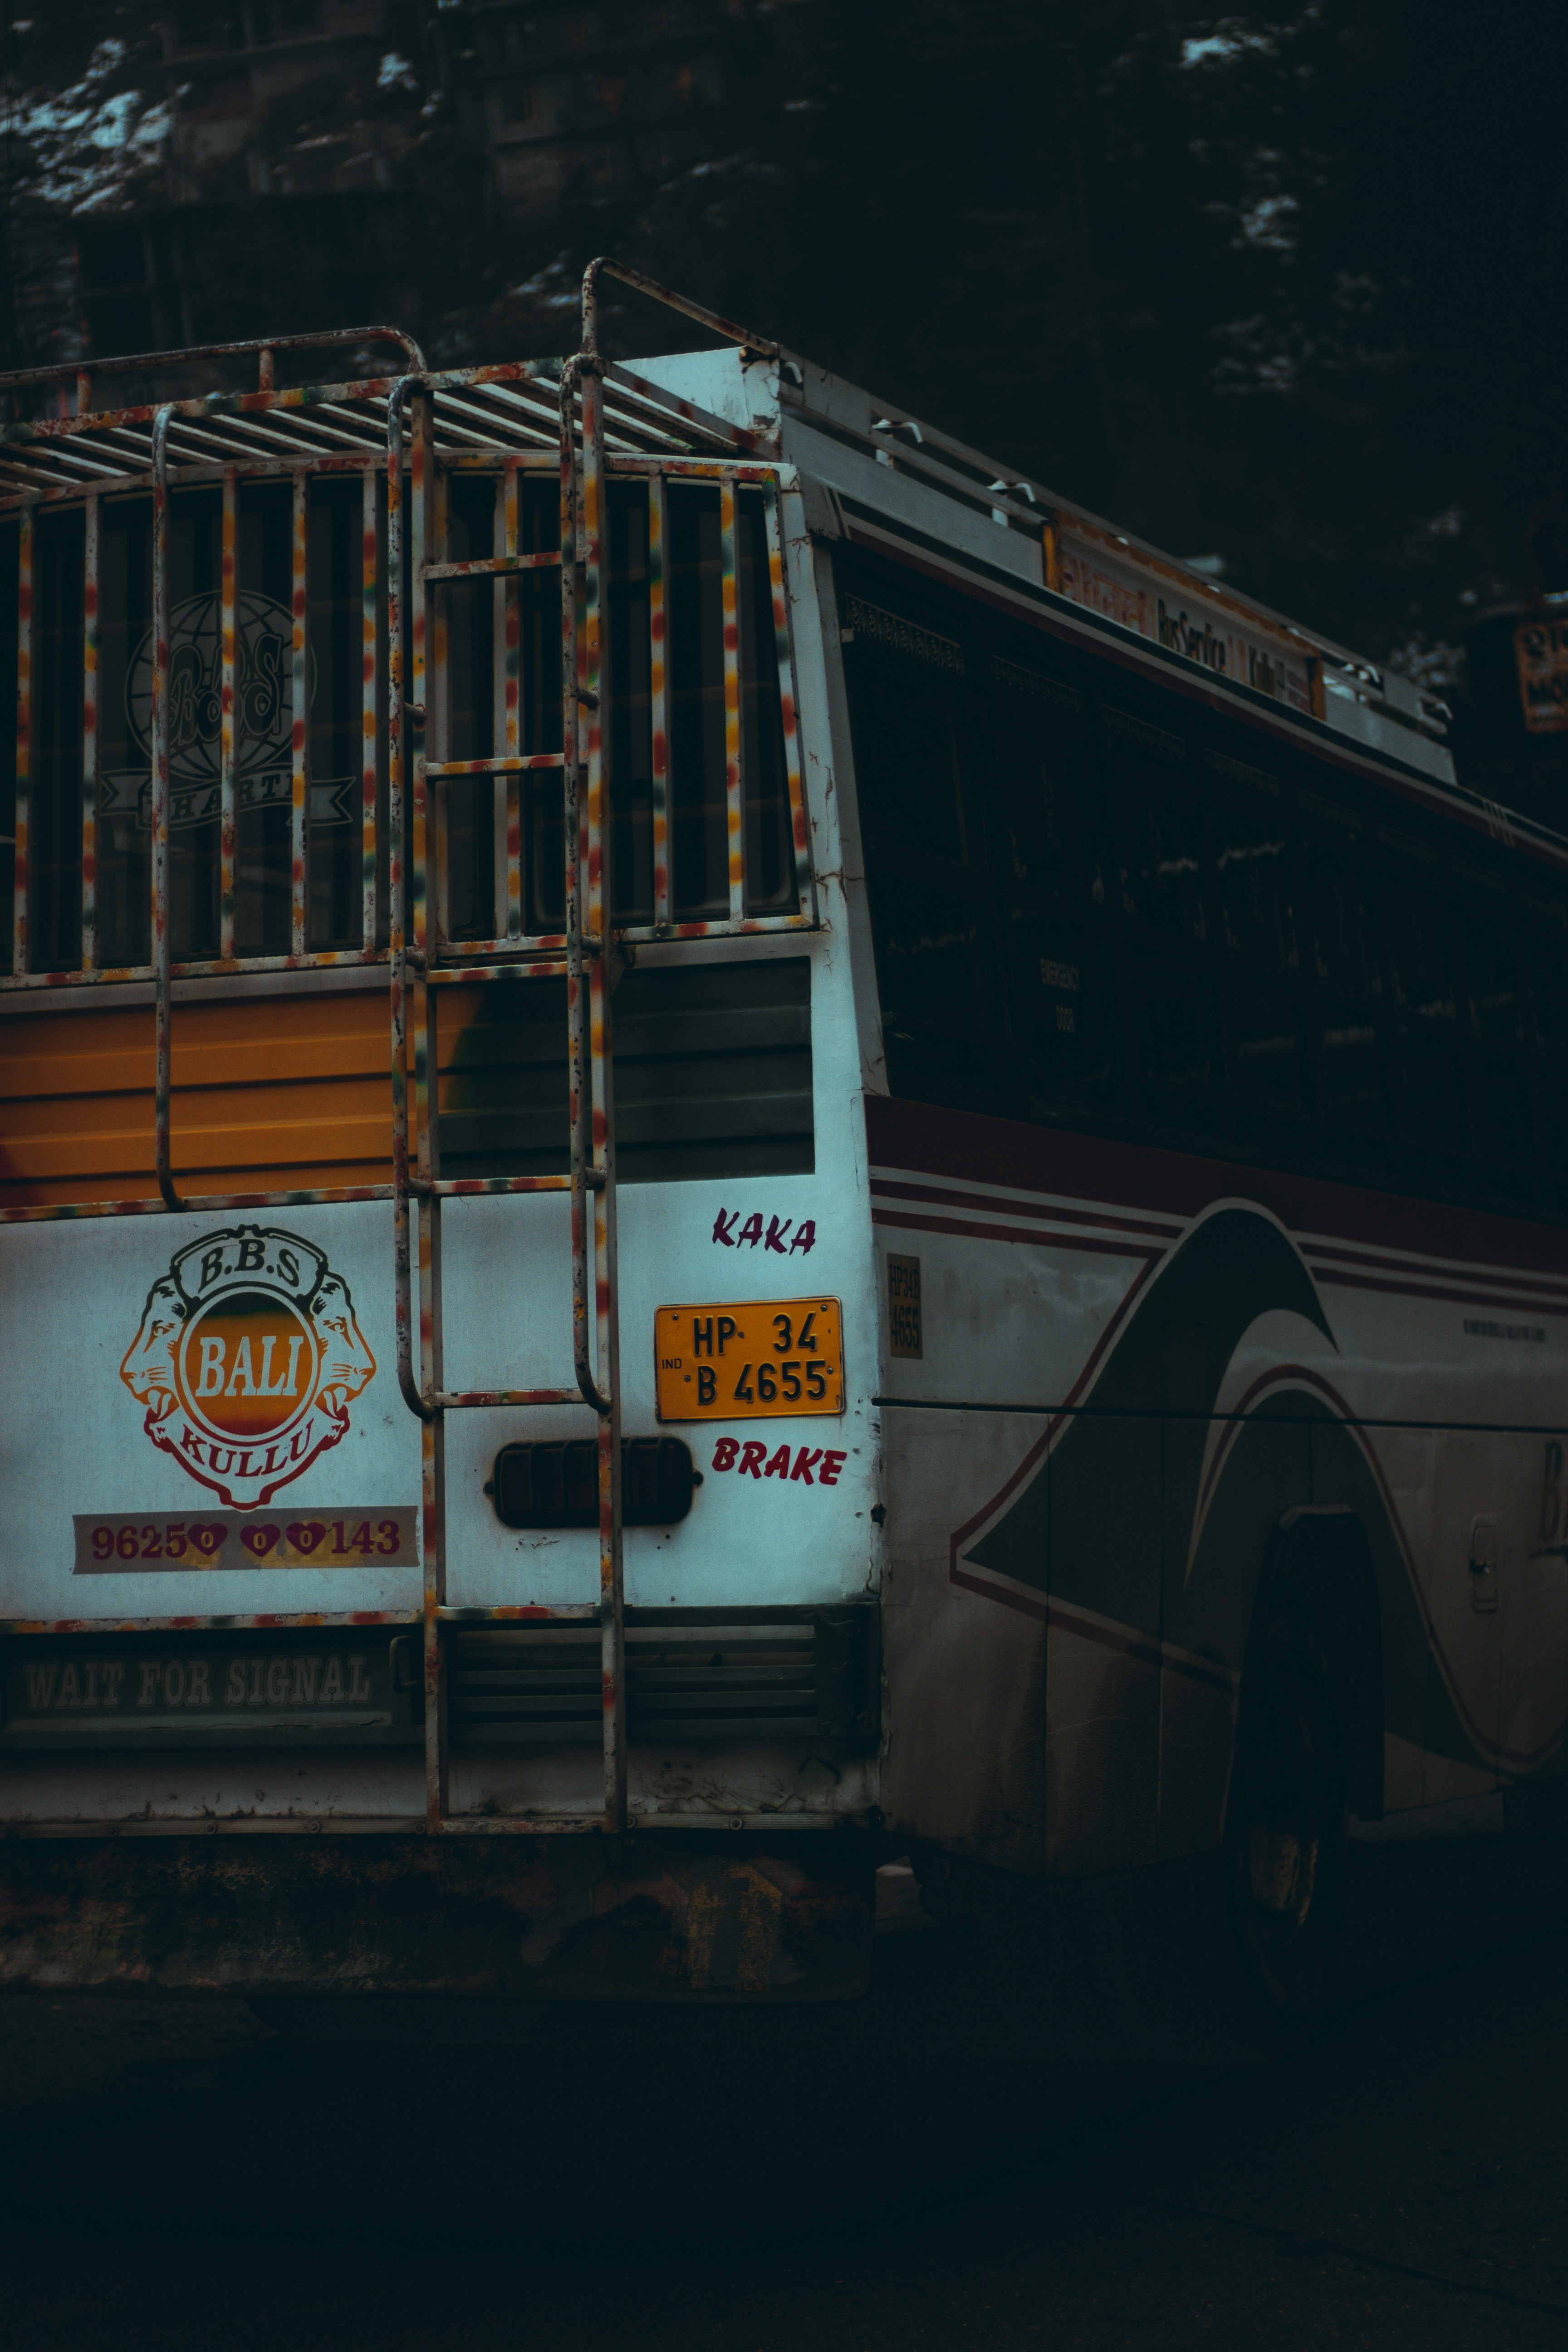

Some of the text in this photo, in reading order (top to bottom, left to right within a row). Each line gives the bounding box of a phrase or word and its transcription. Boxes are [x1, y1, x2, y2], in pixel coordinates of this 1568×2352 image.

[712, 1207, 816, 1256] KAKA
[889, 1264, 919, 1299] HP34B
[693, 1311, 818, 1356] HP 34
[891, 1305, 920, 1349] 4655
[195, 1336, 304, 1397] BALI
[662, 1358, 682, 1370] IND
[697, 1359, 826, 1405] B 4655
[180, 1418, 314, 1477] KULLU
[711, 1437, 847, 1485] BRAKE
[24, 1655, 371, 1710] WAIT FOR SIGNAL
